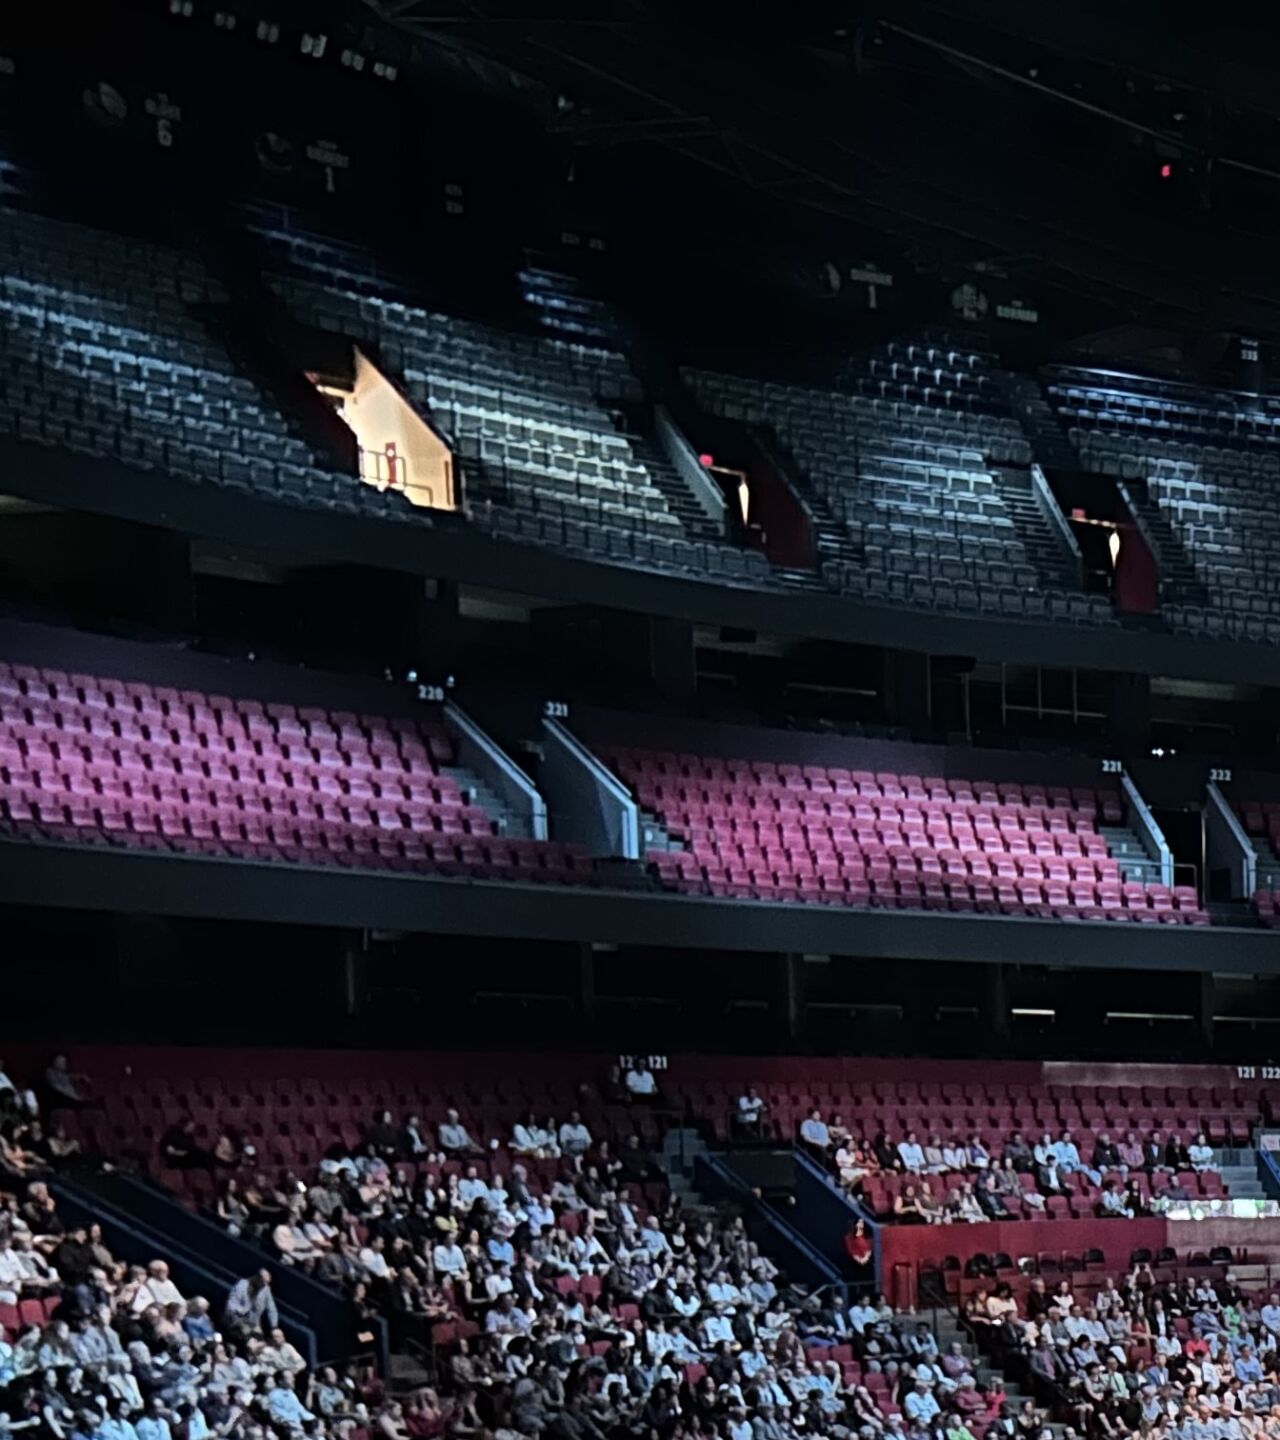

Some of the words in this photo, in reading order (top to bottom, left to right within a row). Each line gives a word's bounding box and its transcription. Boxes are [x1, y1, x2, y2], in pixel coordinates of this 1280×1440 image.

[545, 701, 568, 717] 221
[1102, 760, 1122, 773] 221
[1210, 768, 1232, 781] 222
[619, 1054, 638, 1069] 12
[648, 1055, 668, 1070] 121
[1238, 1066, 1255, 1079] 121
[1262, 1066, 1280, 1079] 122
